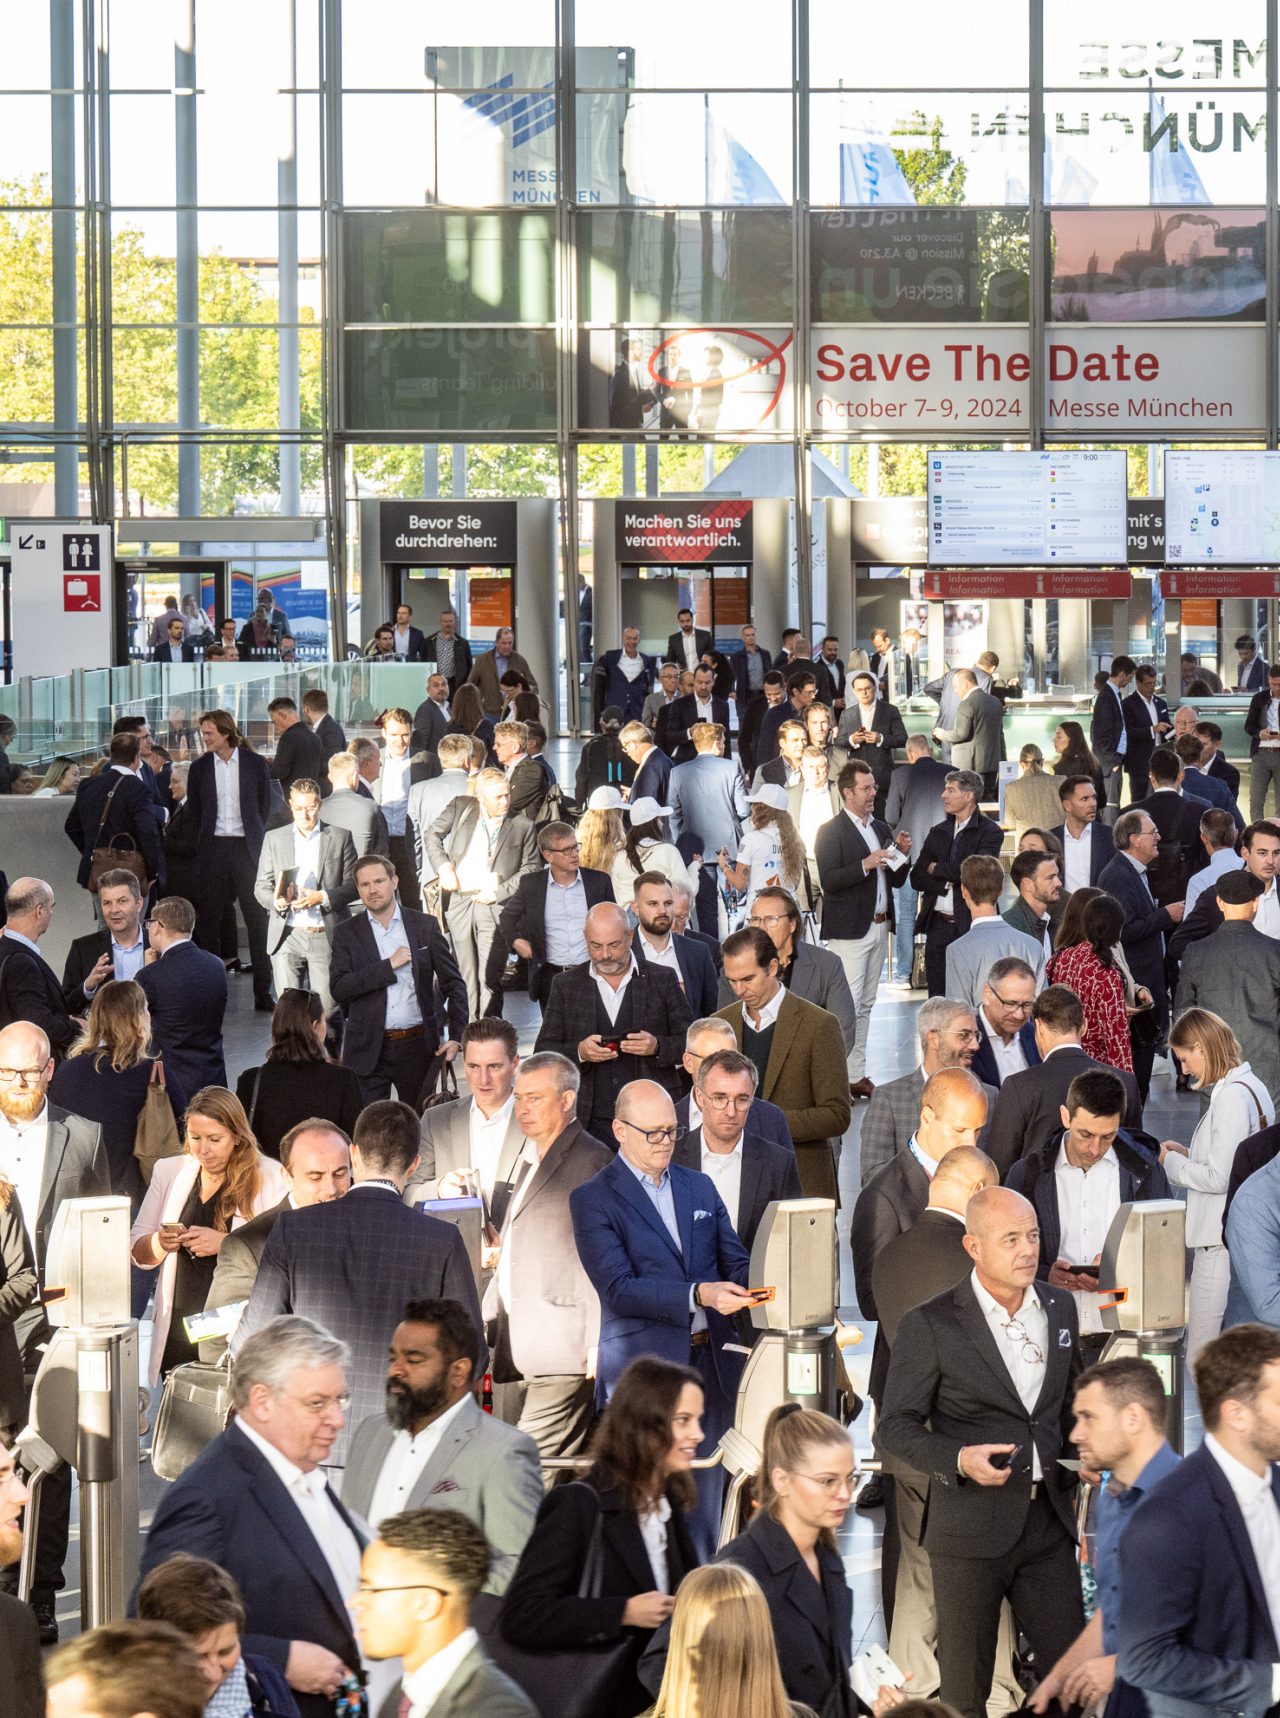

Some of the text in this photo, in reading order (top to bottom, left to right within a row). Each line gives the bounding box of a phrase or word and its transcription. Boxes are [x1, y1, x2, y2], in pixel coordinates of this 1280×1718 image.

[513, 170, 557, 183] MESS
[513, 188, 600, 203] MÜNEN
[816, 345, 1160, 382] Save The Date
[816, 396, 907, 418] October
[967, 397, 1022, 418] 2024
[1048, 397, 1120, 418] Messe
[1127, 396, 1233, 418] München
[1083, 453, 1099, 461] 9:00
[409, 515, 482, 529] Bevor Sie
[624, 513, 742, 529] Machen Sie uns
[395, 533, 498, 548] durchdrehen:
[624, 532, 741, 547] verantwortlich.
[948, 574, 1109, 583] Information Information
[1185, 574, 1241, 583] Information
[949, 585, 1109, 594] Information Information
[1186, 584, 1241, 594] Information
